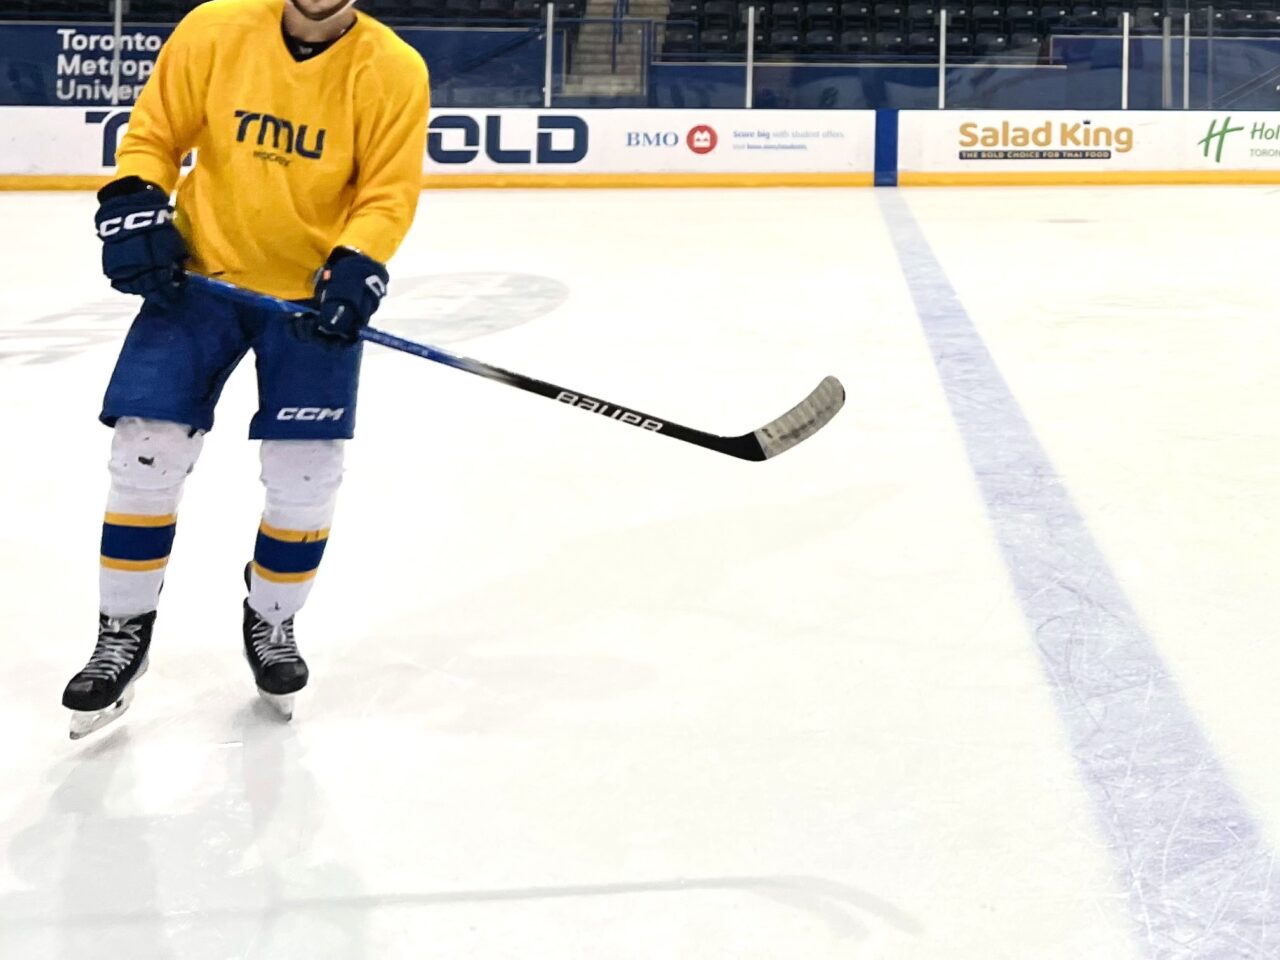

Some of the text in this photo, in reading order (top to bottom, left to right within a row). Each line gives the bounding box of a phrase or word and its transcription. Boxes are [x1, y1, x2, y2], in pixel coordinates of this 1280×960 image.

[57, 28, 161, 51] Toronto
[235, 110, 326, 159] TMU
[626, 131, 679, 147] BMO
[959, 120, 1133, 153] Salad King
[276, 407, 344, 421] CCM
